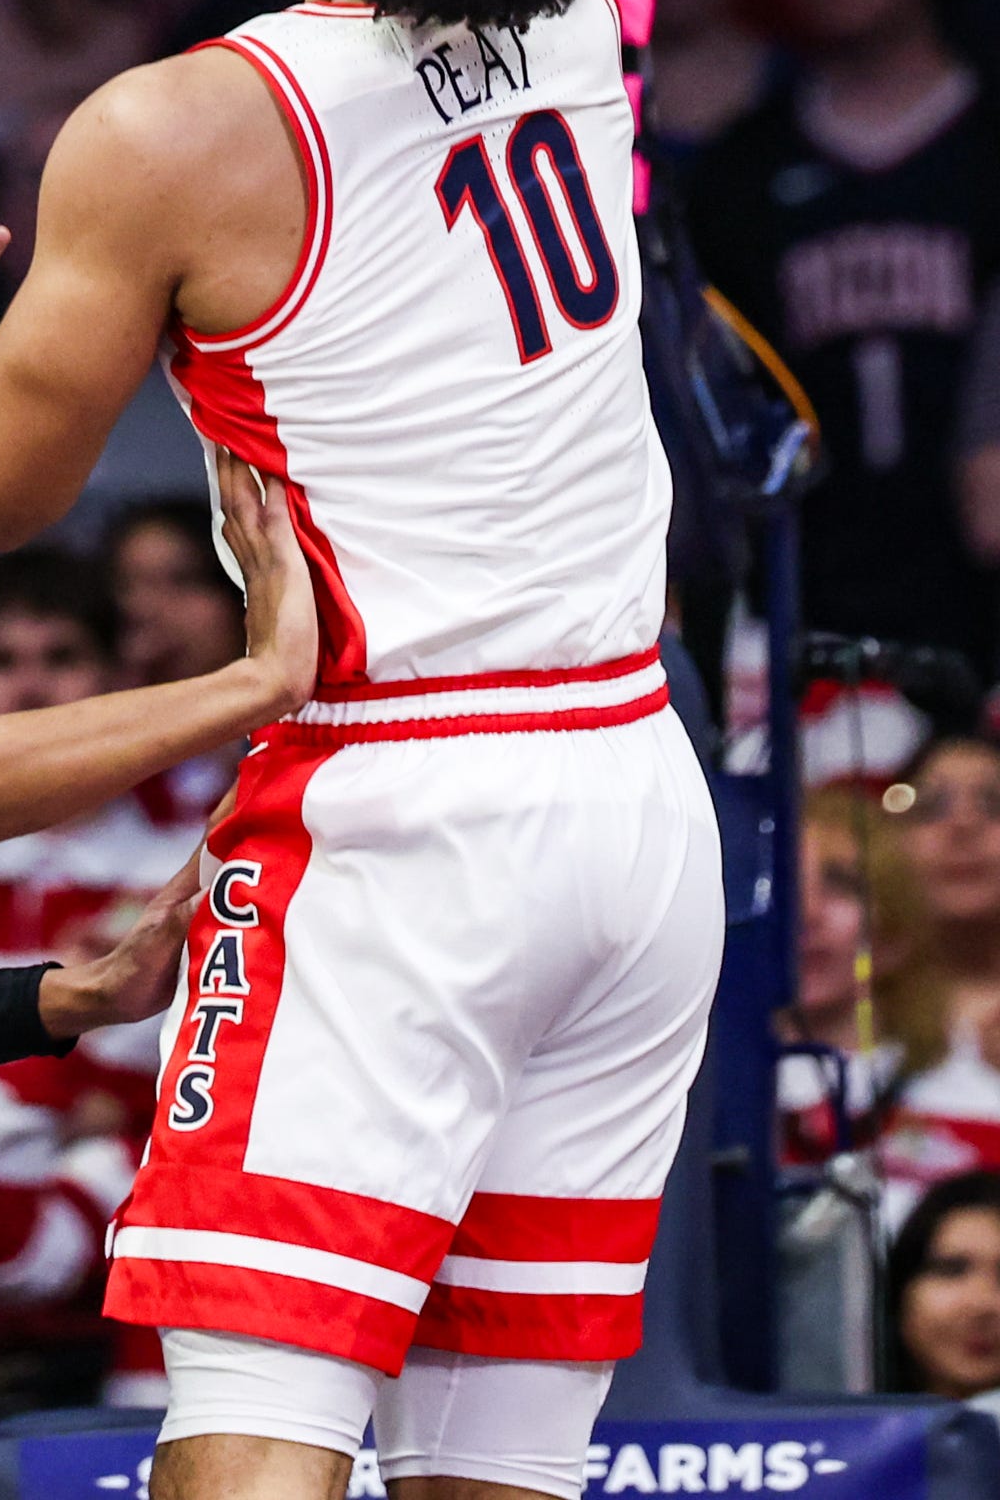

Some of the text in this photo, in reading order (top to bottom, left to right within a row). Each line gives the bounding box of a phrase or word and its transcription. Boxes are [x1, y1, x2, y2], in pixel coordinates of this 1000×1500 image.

[434, 108, 619, 365] 10
[167, 859, 263, 1132] CATS
[582, 1441, 810, 1494] FARMS
